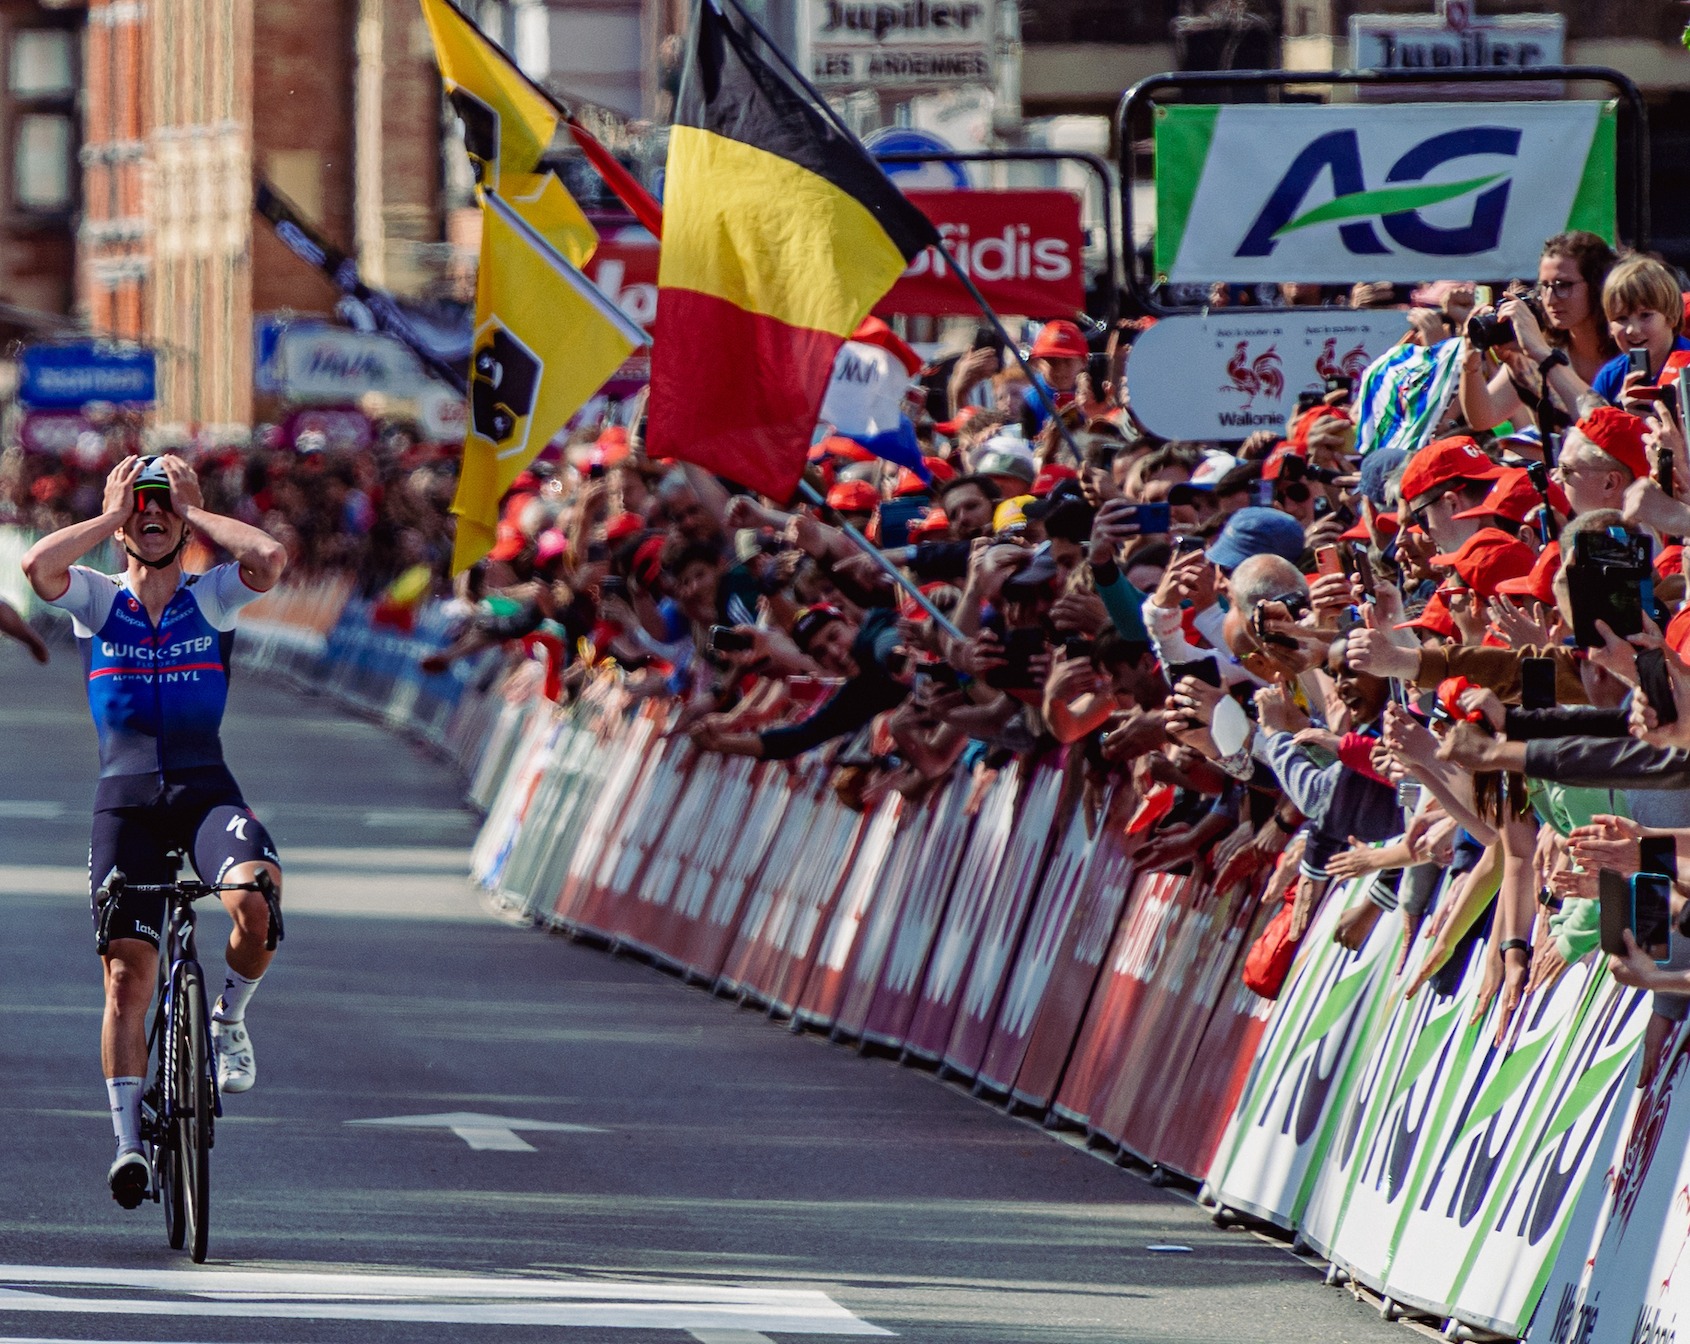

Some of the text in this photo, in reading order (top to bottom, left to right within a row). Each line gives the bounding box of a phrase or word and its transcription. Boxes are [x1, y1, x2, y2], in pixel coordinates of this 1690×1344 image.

[822, 0, 983, 41] Jupiler
[1234, 125, 1523, 258] AG
[902, 222, 1073, 282] fidis
[1218, 411, 1285, 427] Wallonie
[101, 636, 213, 660] QUICK-STEP
[143, 670, 201, 684] VINYL
